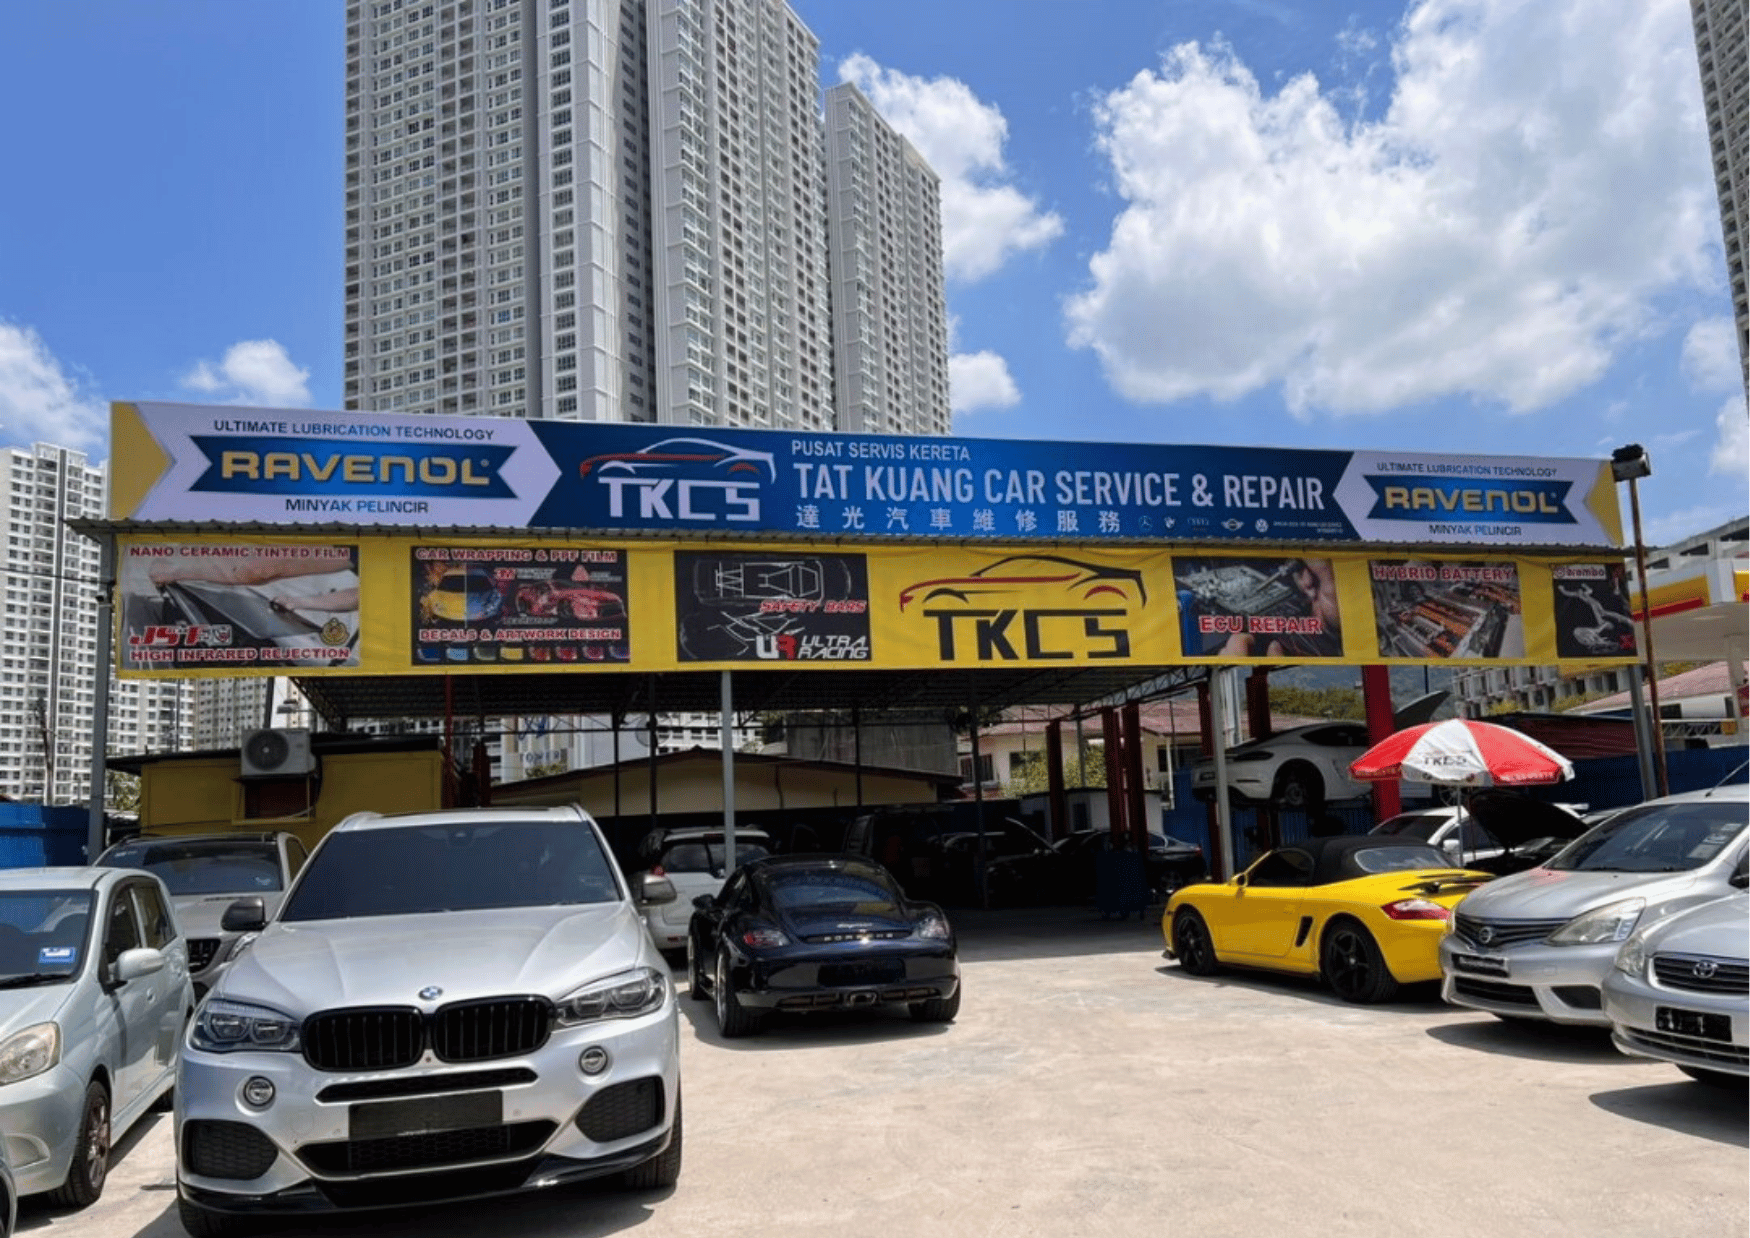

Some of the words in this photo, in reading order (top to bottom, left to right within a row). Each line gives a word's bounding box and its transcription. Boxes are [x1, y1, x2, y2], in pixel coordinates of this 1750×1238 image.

[213, 420, 287, 433] ULTIMATE
[292, 423, 391, 437] LUBRICATION
[395, 426, 494, 440] TECHNOLOGY
[792, 440, 843, 457] PUSAT
[848, 442, 905, 459] SERVIS
[910, 445, 970, 461] KERETA
[222, 450, 490, 485] RAVENOL
[1377, 462, 1424, 473] ULTIMATE
[1427, 464, 1491, 475] LUBRICATION
[1494, 466, 1557, 477] TECHNOLOGY
[794, 463, 852, 500] TAT
[866, 466, 974, 502] KUANG
[984, 468, 1046, 504] CAR
[1056, 470, 1181, 506] SERVICE
[1192, 474, 1214, 507] &
[1224, 475, 1325, 510] REPAIR
[286, 498, 351, 513] MINYAK
[357, 500, 428, 514] PELINCIR
[598, 477, 760, 521] TKCS
[1385, 487, 1558, 513] RAVENOL
[1429, 524, 1472, 535] MINYAK
[1475, 525, 1522, 536] PELINCIR
[130, 547, 174, 557] NANO
[179, 547, 249, 557] CERAMIC
[256, 547, 309, 557] TINTED
[314, 547, 350, 558] FILM
[416, 549, 450, 560] CAR
[452, 549, 532, 561] WRAPPING
[535, 550, 548, 561] &
[582, 551, 618, 563] FILM
[1373, 566, 1436, 580] HYBRID
[1441, 567, 1515, 581] BATTERY
[1198, 615, 1243, 633] ECU
[1248, 616, 1323, 634] REPAIR
[419, 629, 478, 641] DECALS
[480, 629, 493, 641] &
[495, 629, 568, 641] ARTWORK
[569, 628, 622, 640] DESIGN
[801, 635, 867, 647] ULTRA
[923, 609, 1131, 661] TKCS
[130, 649, 174, 661] HIGH
[178, 648, 257, 661] INFRARED
[261, 647, 351, 660] REJECTION
[798, 647, 869, 659] RACING
